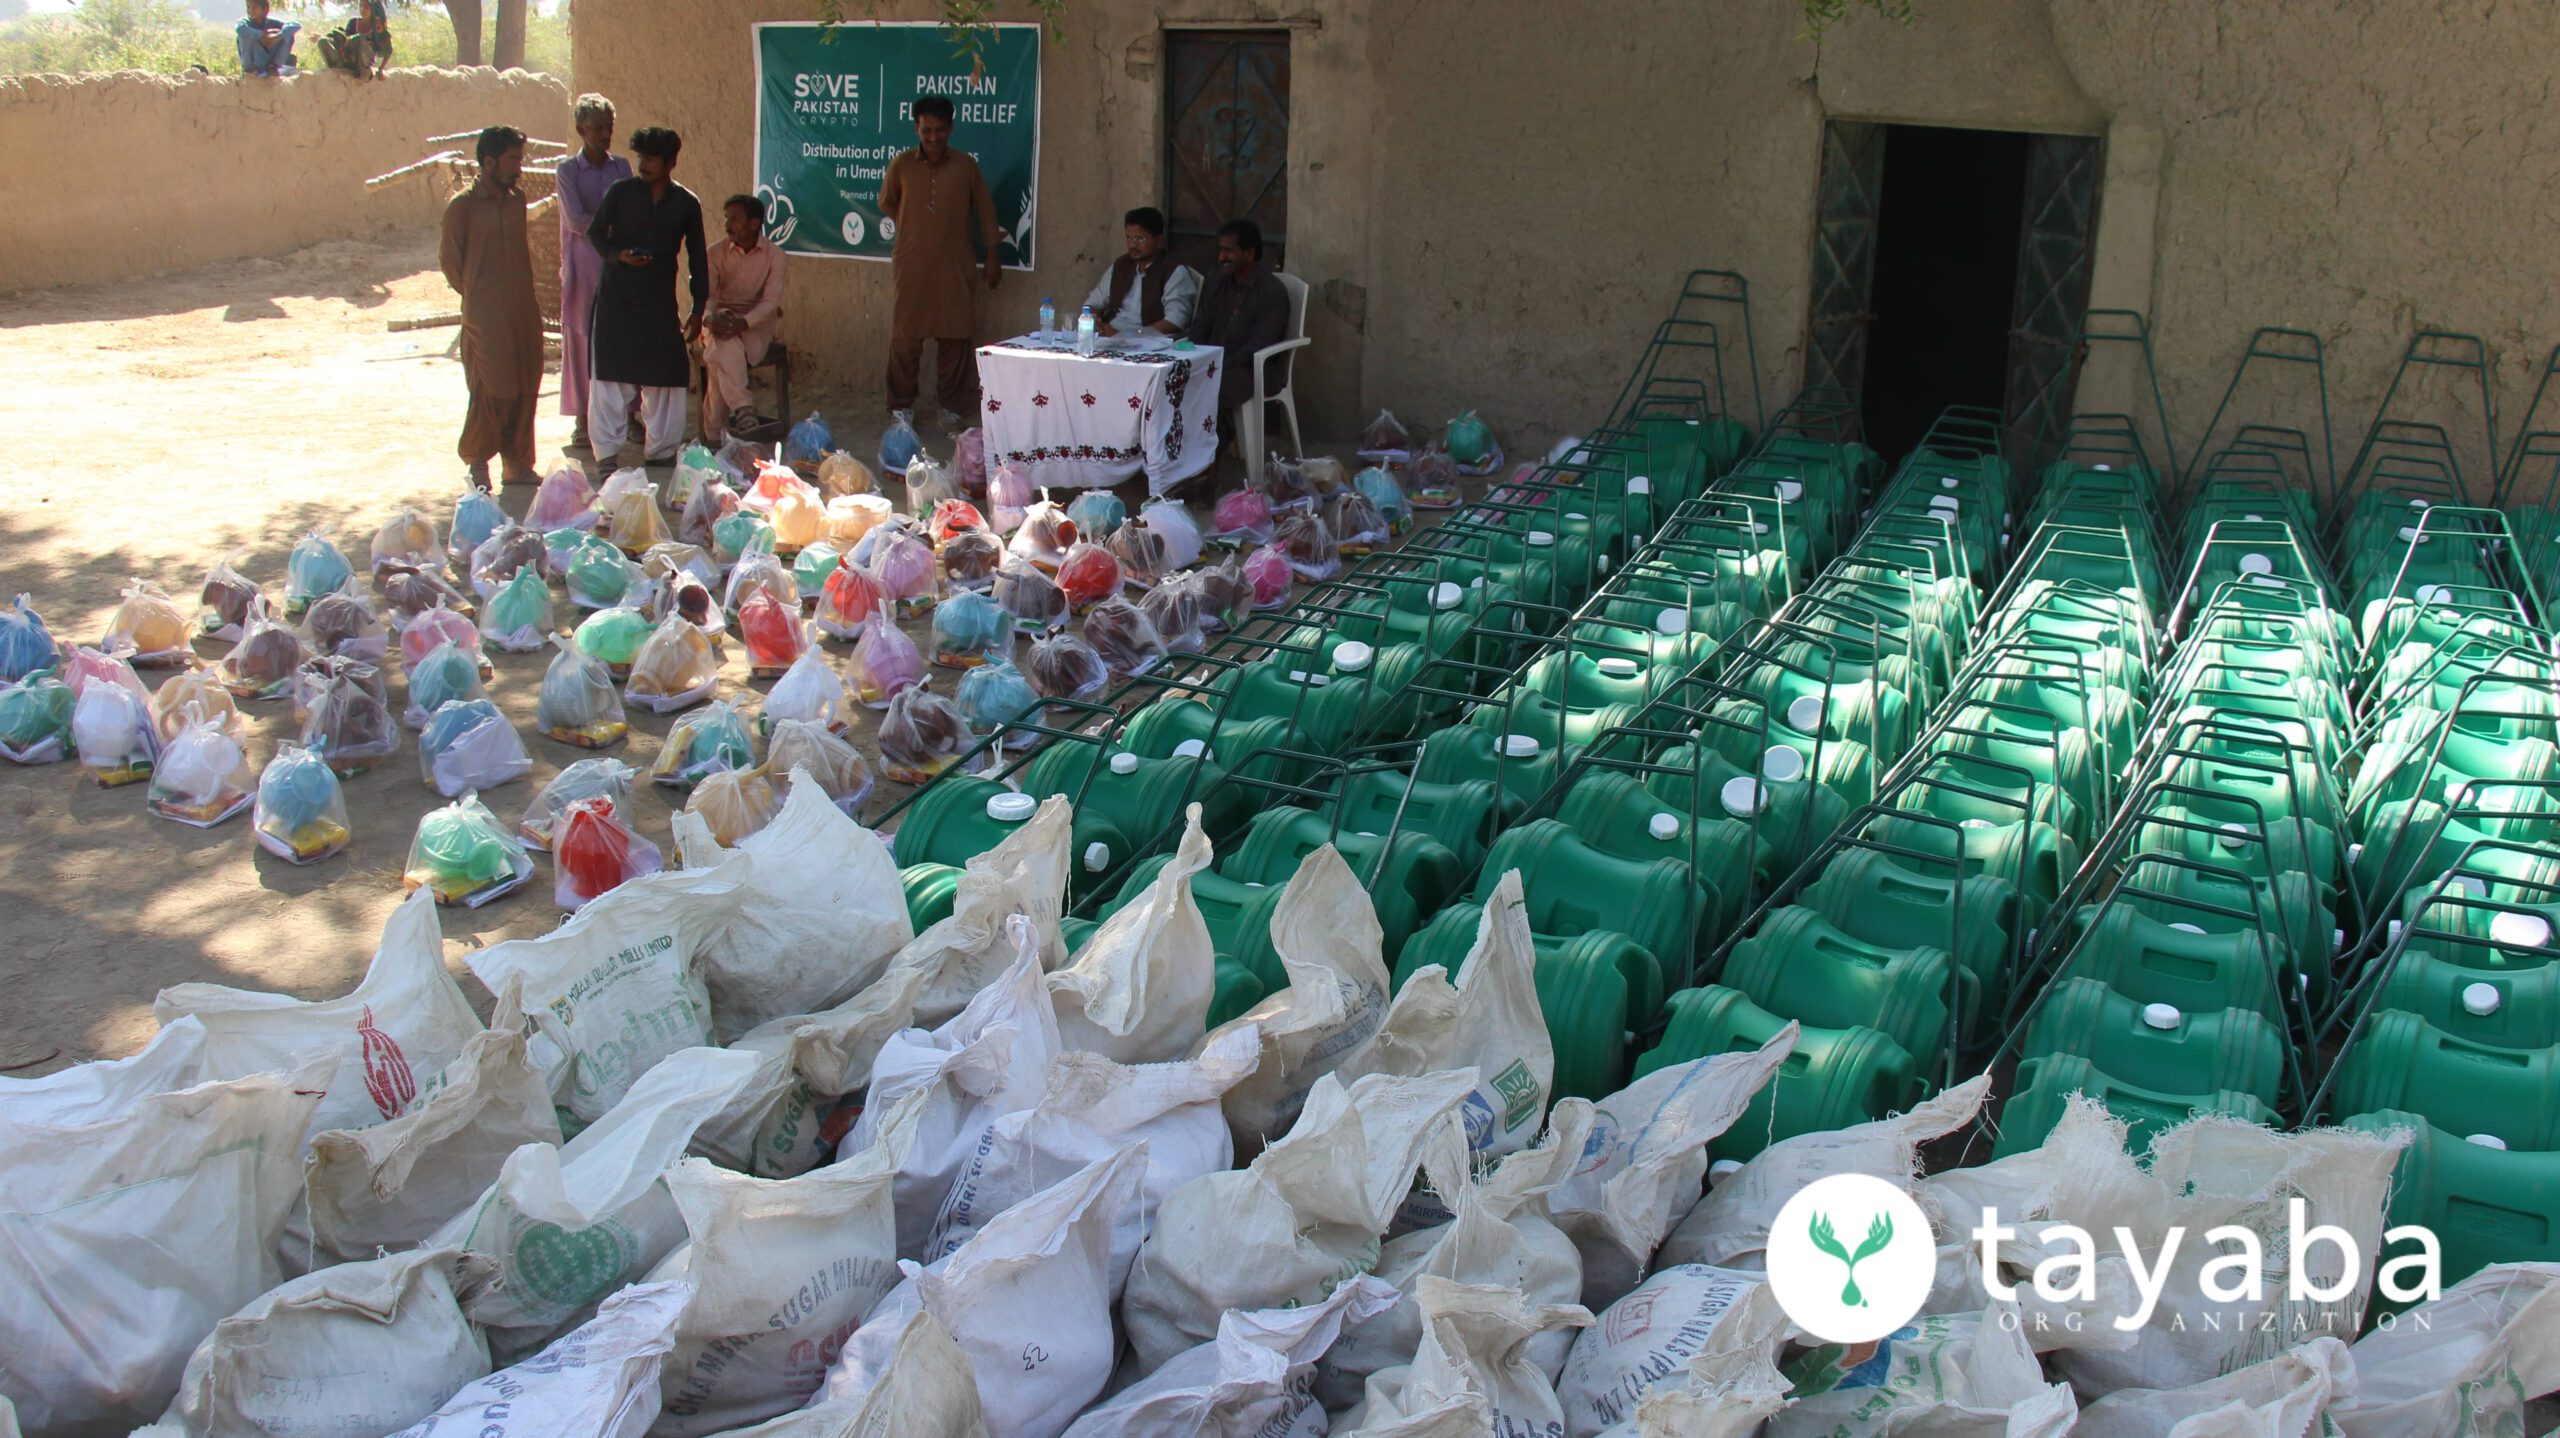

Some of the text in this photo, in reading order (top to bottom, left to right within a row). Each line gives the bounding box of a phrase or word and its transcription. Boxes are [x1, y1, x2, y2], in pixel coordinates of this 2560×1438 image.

[916, 75, 997, 96] PAKISTAN
[794, 100, 858, 114] PAKISTAN
[961, 103, 1017, 124] RELIEF
[800, 115, 858, 127] CRYPTO
[803, 142, 869, 159] Distribution
[872, 146, 886, 160] of
[836, 163, 847, 179] in
[956, 1183, 977, 1226] DIGRI
[768, 1268, 832, 1330] SUGAR
[832, 1255, 883, 1292] MILLS
